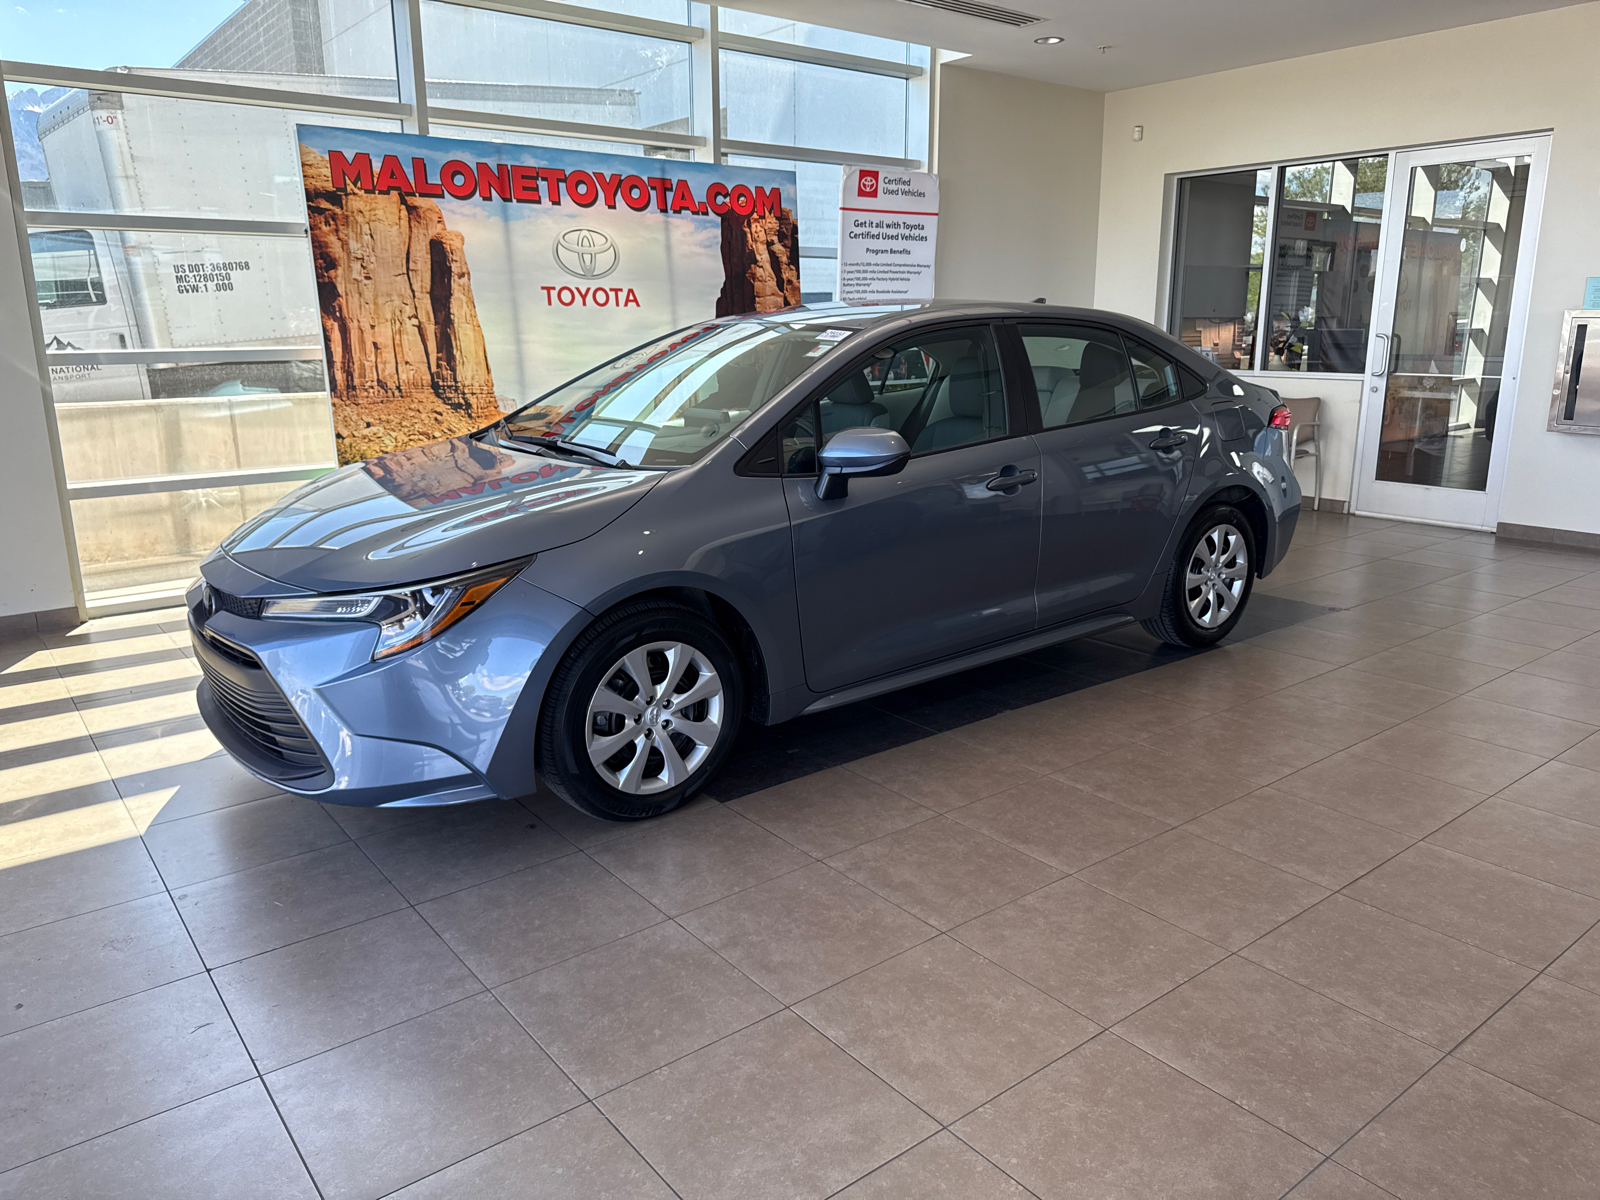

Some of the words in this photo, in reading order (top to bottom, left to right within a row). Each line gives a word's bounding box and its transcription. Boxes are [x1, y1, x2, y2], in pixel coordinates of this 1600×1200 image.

[328, 150, 782, 218] MALONETOYOTA.COM
[883, 176, 911, 186] Certified
[882, 187, 899, 196] Used
[900, 188, 926, 198] Vehicles
[853, 219, 867, 228] Get
[868, 219, 874, 229] it
[875, 220, 885, 229] all
[885, 221, 901, 230] with
[902, 222, 925, 232] Toyota
[848, 231, 880, 240] Certified
[881, 232, 899, 241] Used
[900, 232, 928, 242] Vehicles
[865, 247, 889, 256] Program
[173, 264, 186, 274] US
[210, 261, 250, 272] 3680768
[175, 272, 231, 284] MC:1280150
[541, 286, 641, 308] TOYOTA
[51, 365, 102, 375] NATIONAL
